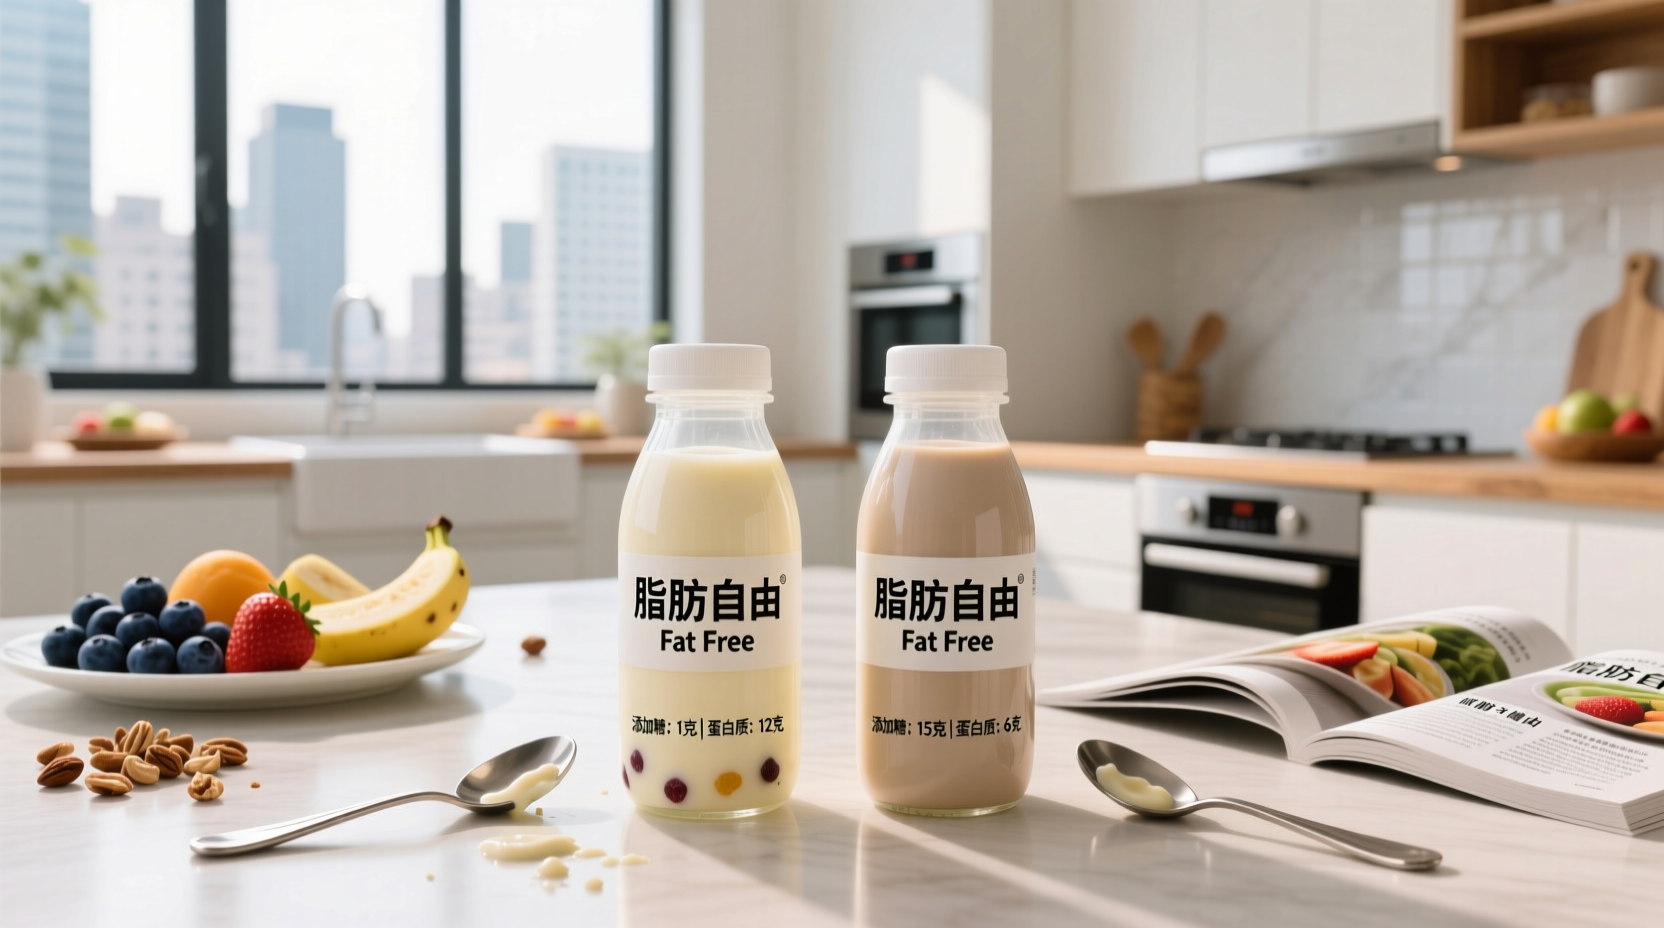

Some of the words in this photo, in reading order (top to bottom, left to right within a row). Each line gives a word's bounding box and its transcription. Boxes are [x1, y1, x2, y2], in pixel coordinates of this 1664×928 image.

[634, 576, 780, 623] 脂肪自由
[874, 576, 1018, 623] 脂肪自由
[660, 629, 697, 653] Fat
[703, 629, 755, 653] Free
[902, 629, 938, 653] Fat
[944, 629, 994, 653] Free
